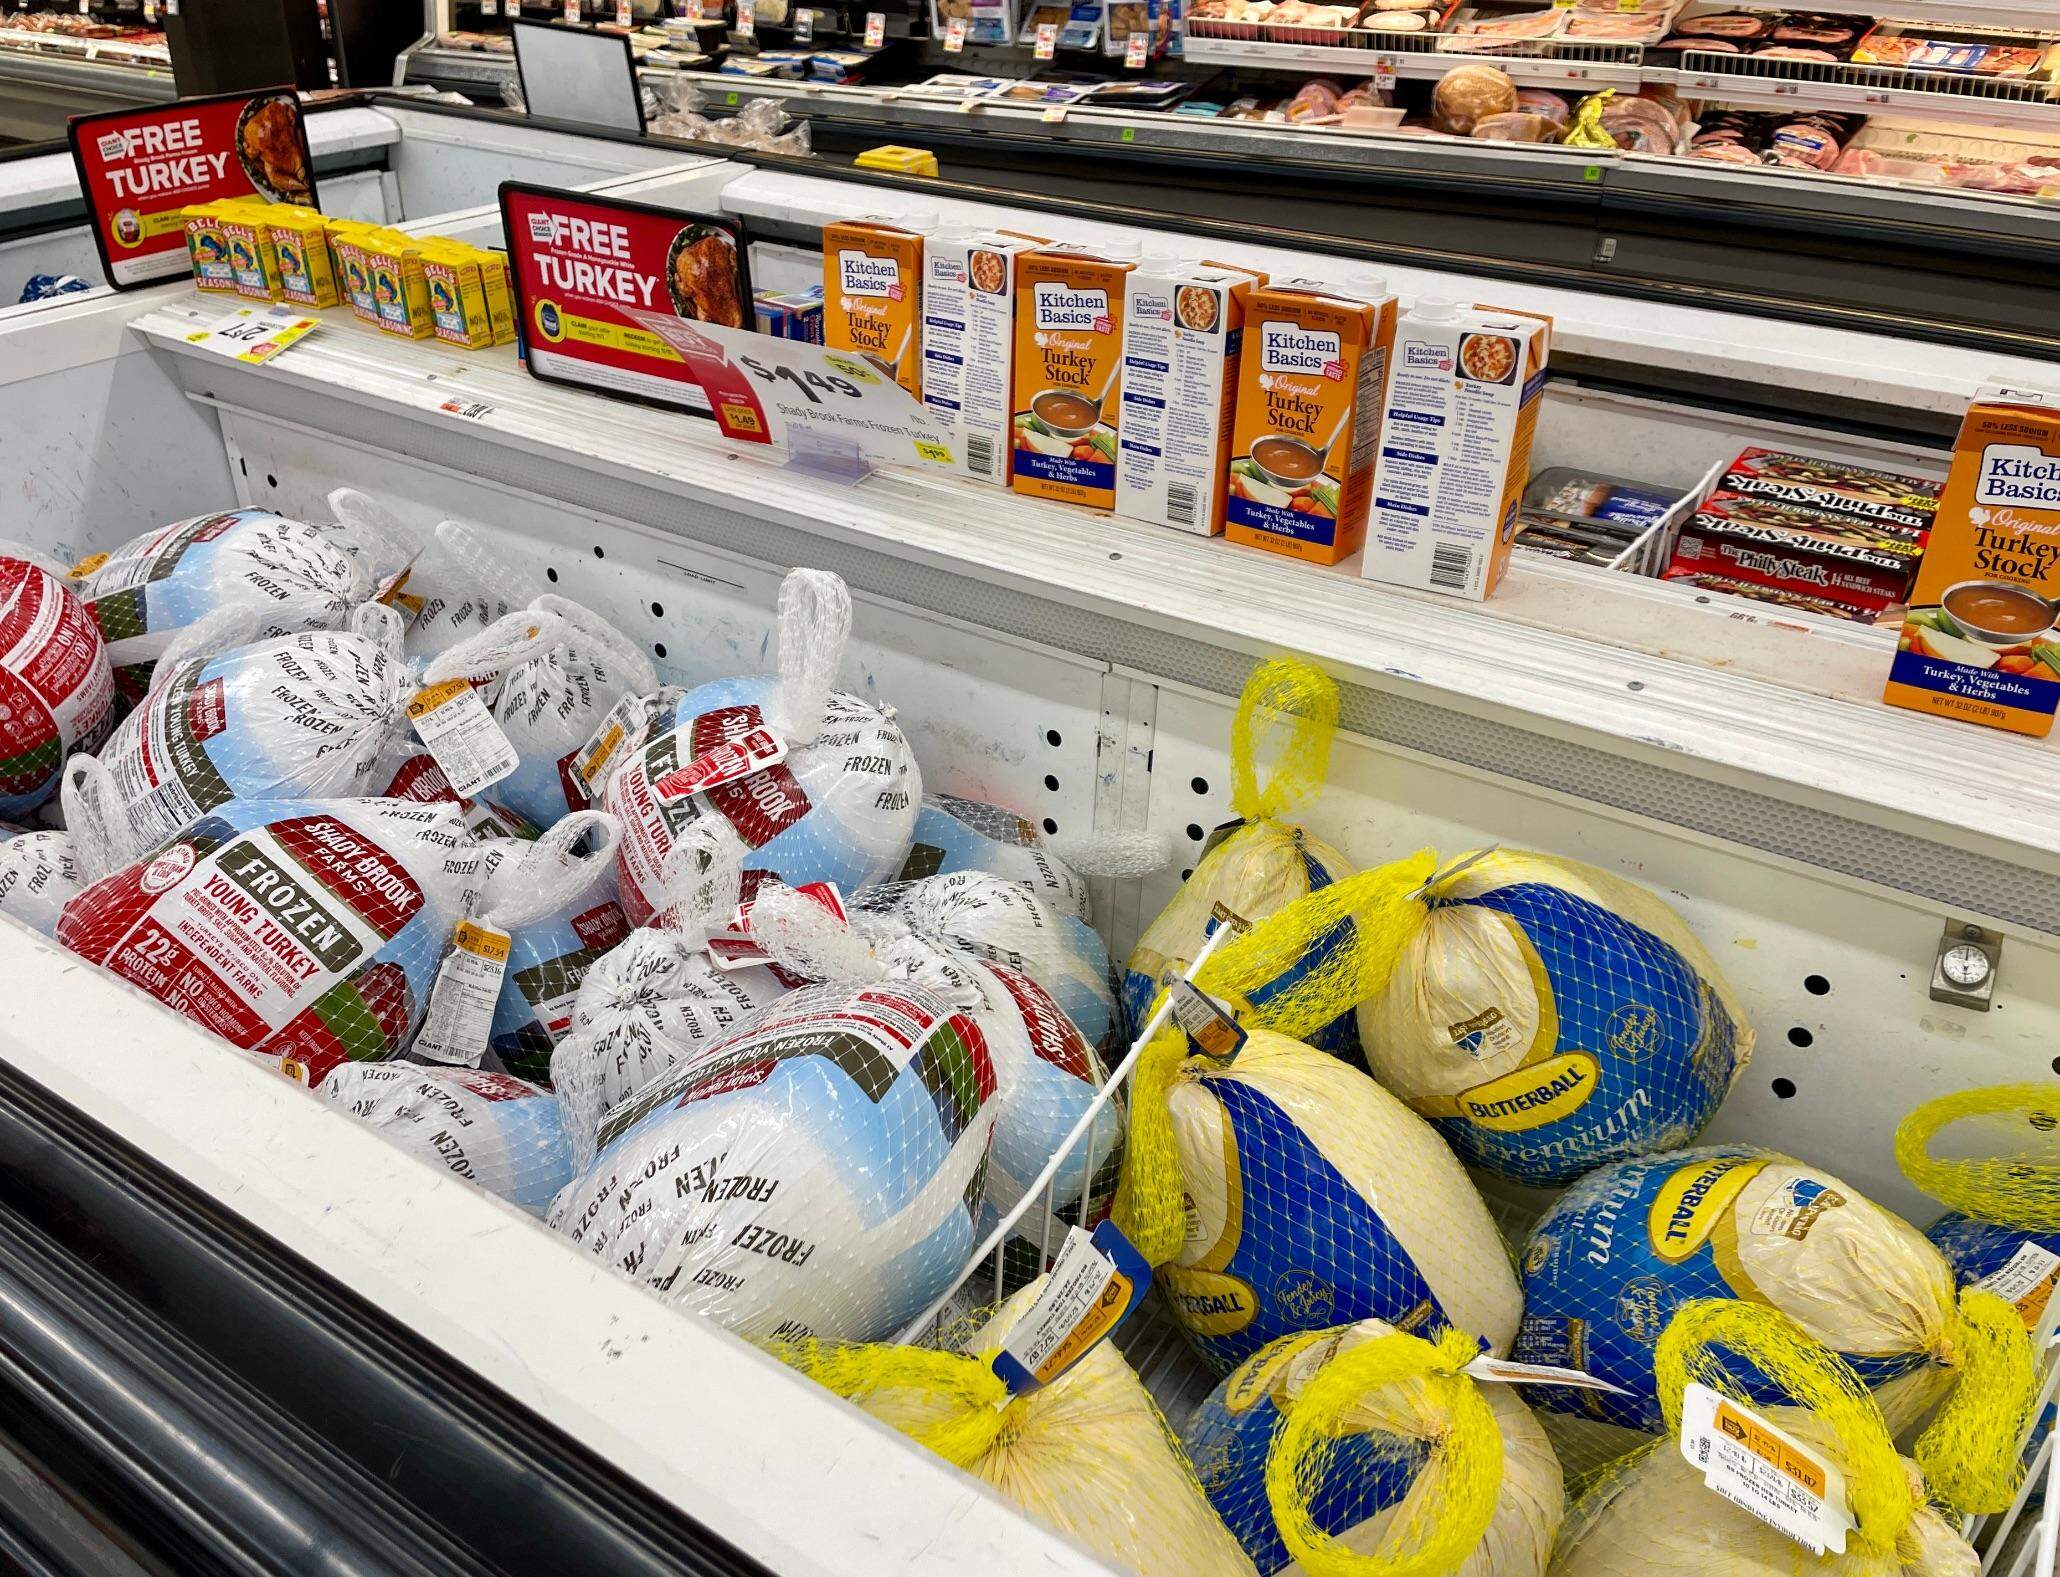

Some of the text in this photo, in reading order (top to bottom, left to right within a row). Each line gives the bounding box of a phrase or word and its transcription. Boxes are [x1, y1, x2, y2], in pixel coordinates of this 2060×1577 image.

[123, 119, 203, 157] FREE
[552, 214, 631, 259] FREE
[424, 264, 456, 284] BELL'S
[844, 260, 897, 276] Kitchen
[934, 261, 961, 271] Kitchen
[934, 269, 956, 278] Basics
[845, 275, 887, 291] Basics
[1040, 293, 1105, 308] Kitchen
[1136, 299, 1167, 308] Kitchen
[1136, 307, 1160, 315] Basics
[846, 311, 892, 337] Turkey
[1040, 309, 1092, 324] Basics
[850, 327, 887, 349] Stock
[1049, 332, 1093, 351] Original
[1267, 333, 1337, 352] Kitchen
[1041, 348, 1096, 373] Turkey
[1267, 350, 1322, 368] Basics
[1408, 347, 1447, 357] Kitchen
[1408, 356, 1438, 365] Basics
[1045, 364, 1090, 385] Stock
[1274, 375, 1321, 396] Original
[1265, 390, 1324, 421] Turkey
[1393, 410, 1413, 420] Helpful
[776, 402, 941, 444] Shady Brook Farms Frozen Turkey
[1267, 409, 1316, 433] Stock
[2001, 423, 2018, 433] LESS
[2019, 425, 2049, 437] SODIUM
[1031, 460, 1096, 477] Turkey, Vegetables
[1056, 473, 1078, 482] Herbs
[1989, 458, 2060, 481] Kitch
[1724, 473, 1818, 507] Steak
[1265, 506, 1295, 518] Made With
[1811, 491, 1890, 521] Philly
[1246, 507, 1315, 531] Turkey, Vegetables
[1263, 521, 1295, 535] & Herbs
[1696, 513, 1902, 570] The Philly Steak
[1975, 527, 2060, 565] Turkey
[1720, 544, 1829, 588] The Philly Steak
[1974, 550, 2052, 581] Stock
[244, 571, 291, 601] FROZEN
[1923, 665, 2030, 696] Turkey, Vegetables
[1955, 665, 2000, 680] Made With
[1948, 682, 1997, 700] & Herbs
[1932, 696, 1943, 705] NET
[1944, 698, 1954, 707] WT
[1955, 700, 1963, 710] 32
[1963, 702, 1972, 711] OZ
[171, 706, 200, 779] YOUNG TURKEY
[842, 756, 892, 776] FROZEN
[458, 777, 481, 792] GIANT
[629, 763, 655, 817] YOUNG
[745, 770, 795, 822] ROOK
[304, 821, 416, 912] SHADY BROOK
[236, 858, 342, 952] FROZEN
[203, 874, 321, 981] YOUNG TURKEY
[134, 929, 180, 967] 22g
[178, 919, 264, 1000] INDEPENDENT FARMS
[119, 947, 168, 988] PROTEIN
[179, 972, 250, 1036] NO ADDED HORMONES
[680, 1006, 704, 1040] FROZEN
[1035, 1005, 1066, 1058] SHADY
[1611, 1013, 1637, 1049] Tender
[418, 1040, 442, 1051] GIANT
[719, 1045, 769, 1066] YOUNG
[773, 1035, 835, 1052] FROZEN
[1468, 1067, 1587, 1118] BUTTERBALL
[417, 1083, 474, 1128] FROZEN
[1279, 1280, 1313, 1306] Tender
[1300, 1287, 1331, 1315] Juicy
[1736, 1468, 1760, 1490] FROZEN
[1774, 1491, 1798, 1514] TURKEY
